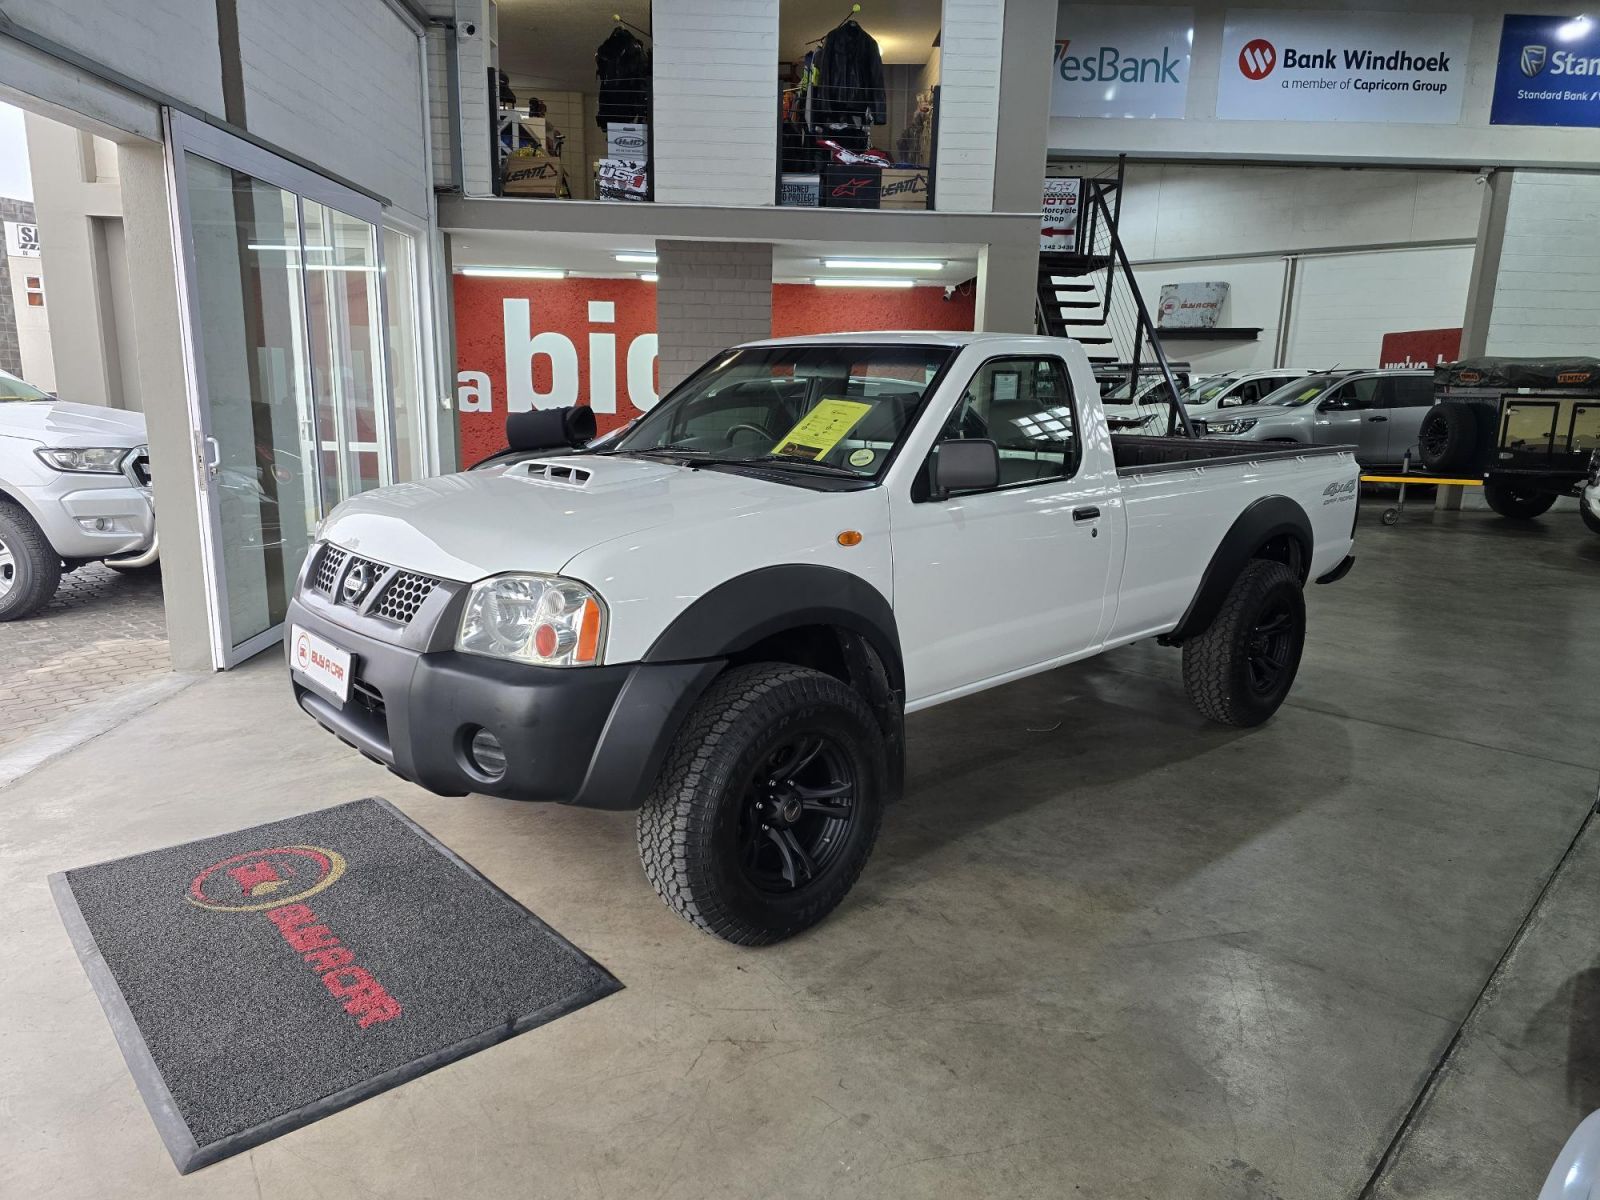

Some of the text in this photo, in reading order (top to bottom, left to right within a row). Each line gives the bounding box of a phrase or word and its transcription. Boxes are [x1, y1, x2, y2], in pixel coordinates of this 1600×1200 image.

[1283, 48, 1450, 72] Bank Windhoek
[1281, 78, 1448, 94] a member of Capricorn Group
[1517, 89, 1588, 101] Standard Bank
[1044, 214, 1064, 223] Shop
[457, 370, 492, 413] a
[311, 649, 344, 681] BUY A CAR
[266, 903, 341, 954] BUY
[321, 965, 402, 1029] CAR
